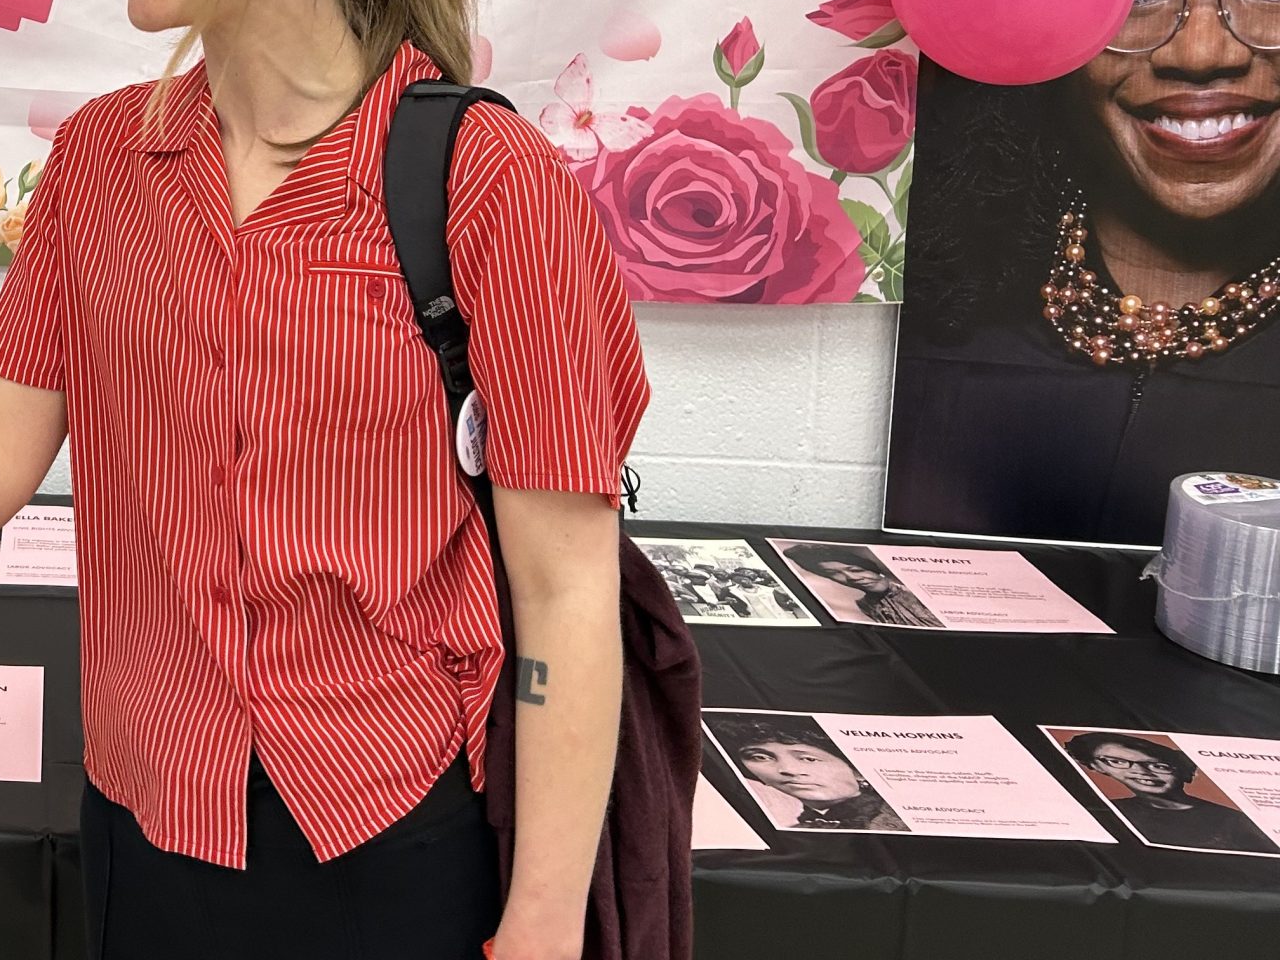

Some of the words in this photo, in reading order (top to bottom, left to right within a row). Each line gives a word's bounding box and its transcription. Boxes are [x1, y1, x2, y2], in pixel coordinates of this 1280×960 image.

[930, 557, 972, 565] WYATT
[839, 729, 892, 738] VELMA
[893, 731, 964, 740] HOPKINS
[1197, 750, 1280, 762] CLAUDETTE
